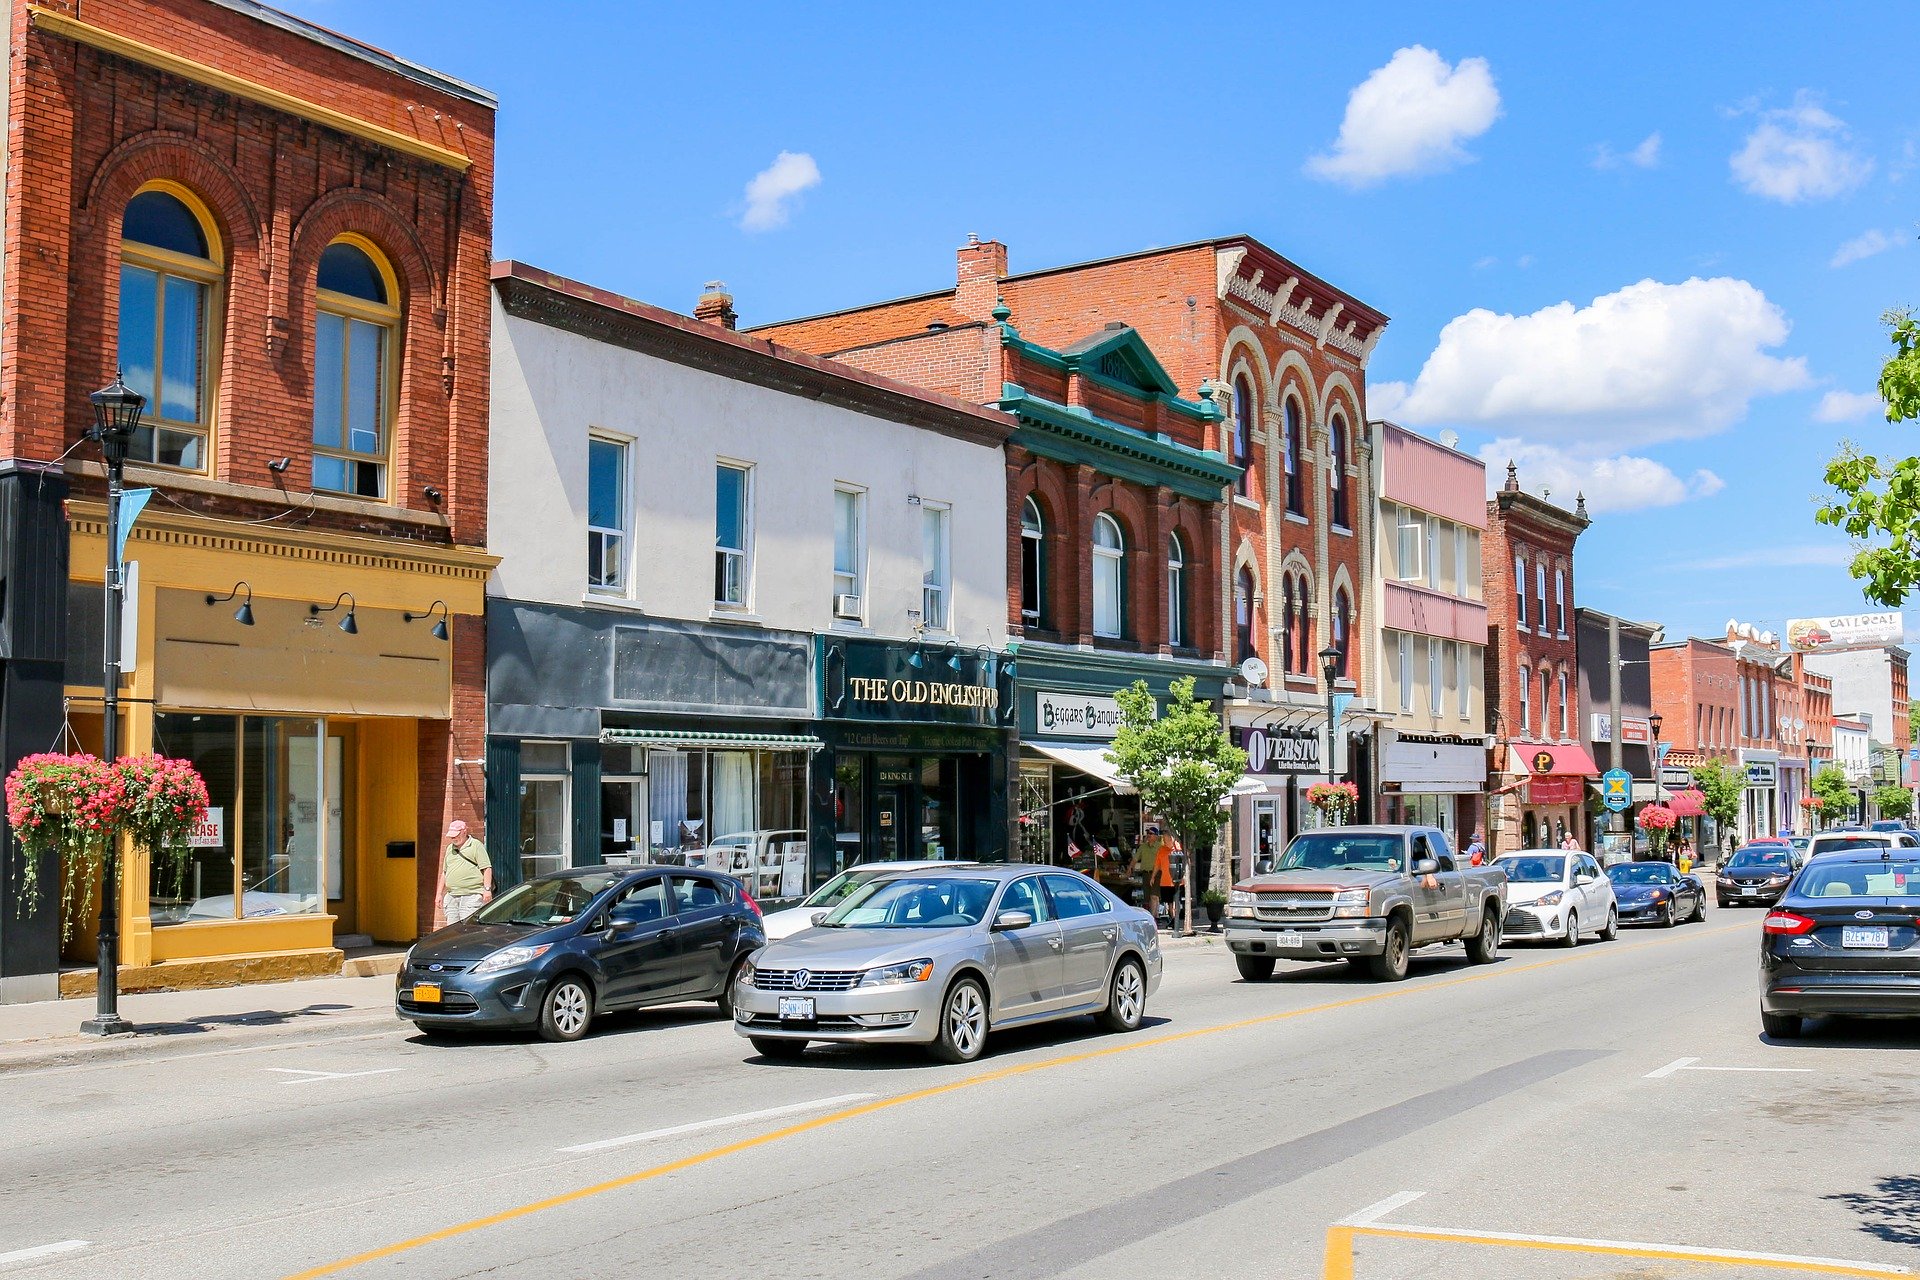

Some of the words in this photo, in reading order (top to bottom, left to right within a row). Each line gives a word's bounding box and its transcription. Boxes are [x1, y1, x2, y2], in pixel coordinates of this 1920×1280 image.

[1829, 618, 1851, 628] EAT
[850, 678, 888, 701] THE
[891, 680, 928, 703] OLD
[930, 682, 981, 706] ENGLISH
[981, 687, 998, 709] PUB
[1249, 730, 1320, 772] OVERSTO
[1537, 754, 1551, 769] P
